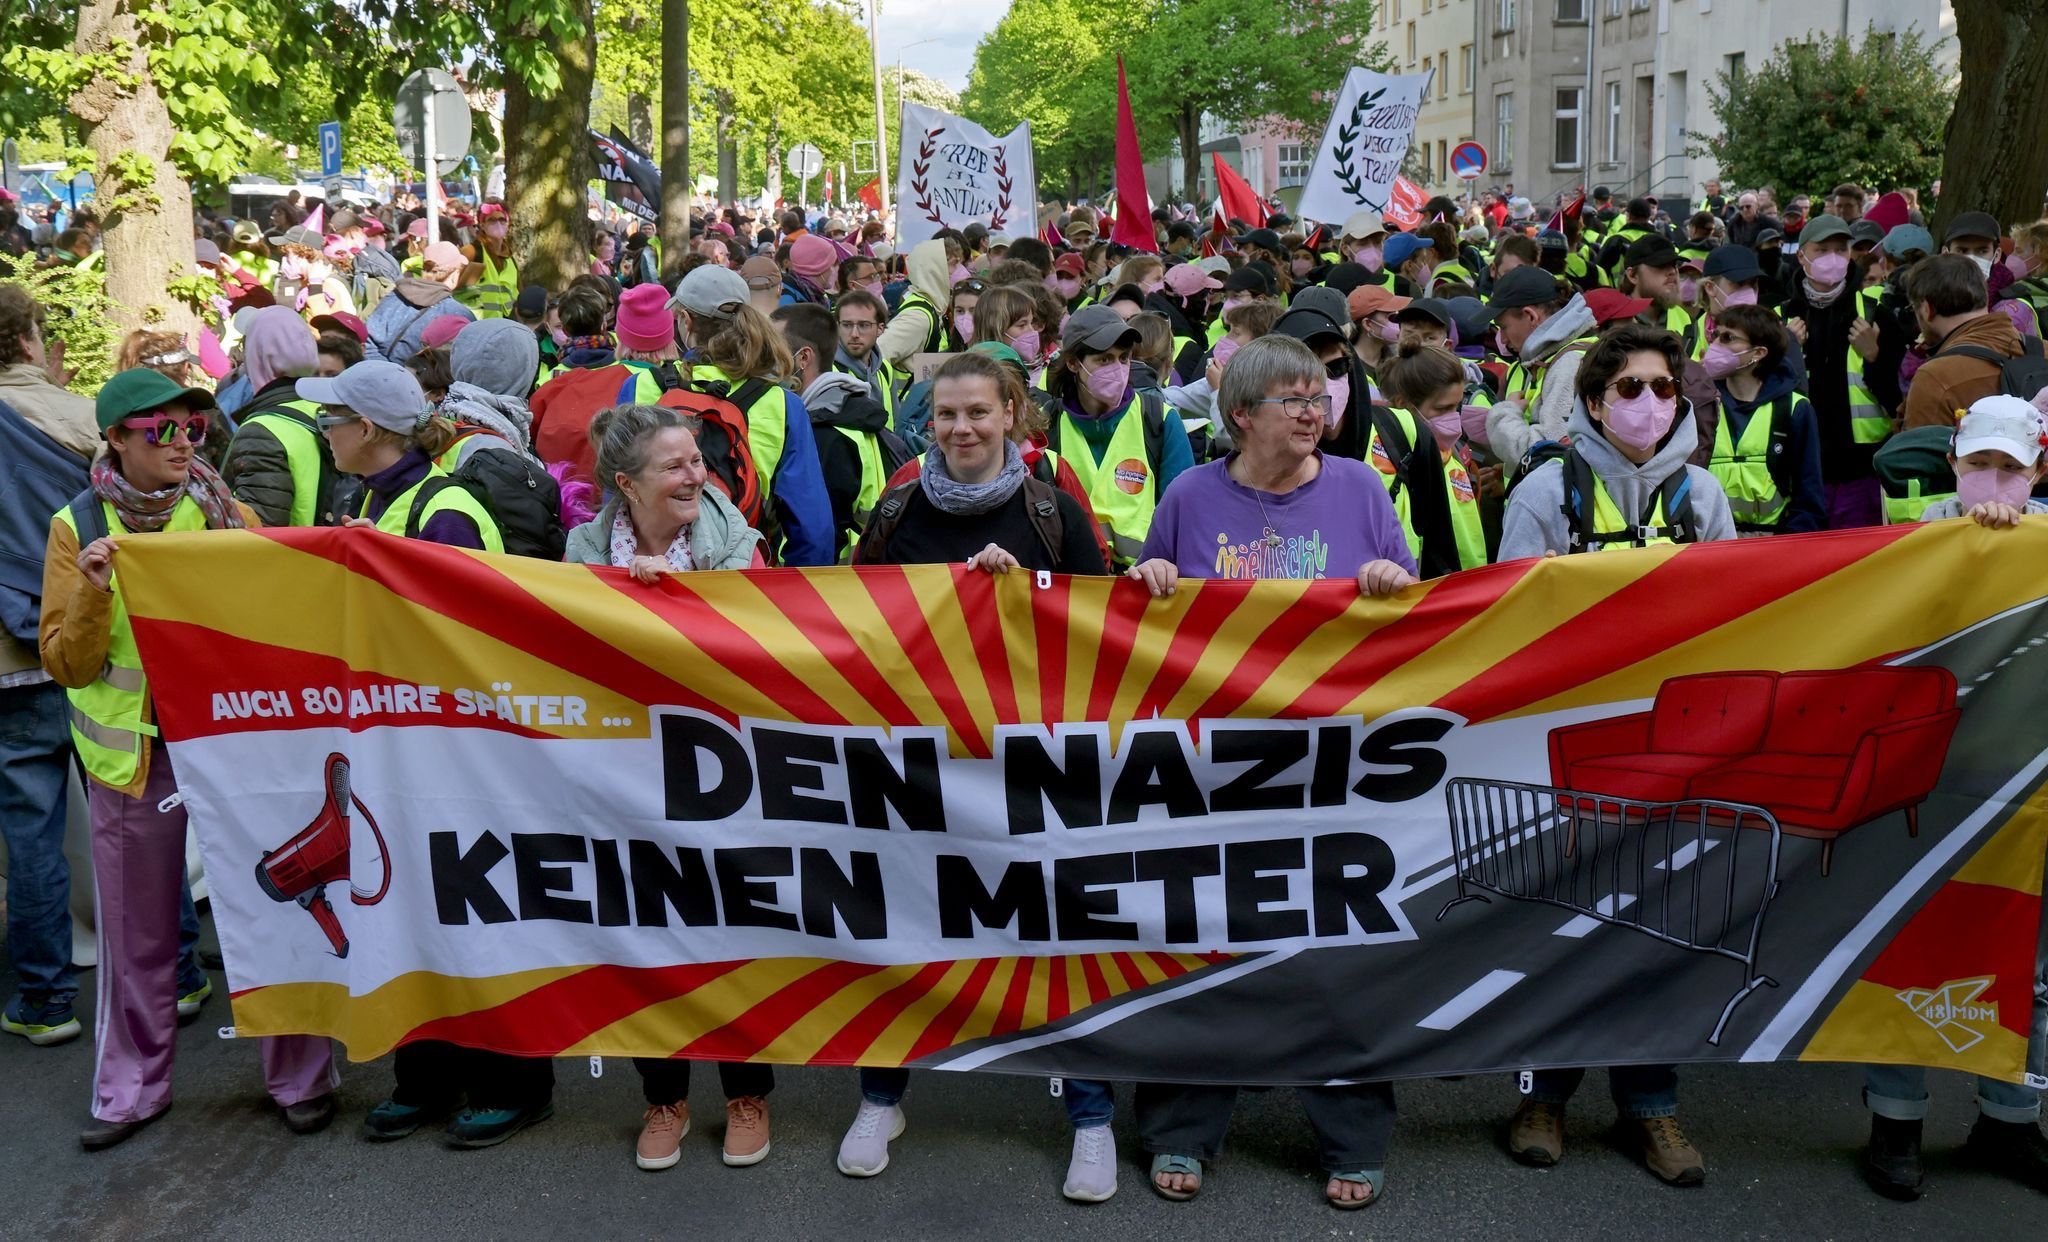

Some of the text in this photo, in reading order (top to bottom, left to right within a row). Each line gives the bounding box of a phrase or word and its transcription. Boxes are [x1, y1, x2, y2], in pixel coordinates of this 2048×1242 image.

[324, 130, 337, 170] P
[212, 690, 295, 721] AUCH
[301, 686, 343, 715] 80
[349, 684, 443, 719] AHRE
[454, 681, 588, 727] SPÄTER
[660, 714, 1455, 835] DEN NAZIS
[429, 830, 1400, 944] KEINEN METER
